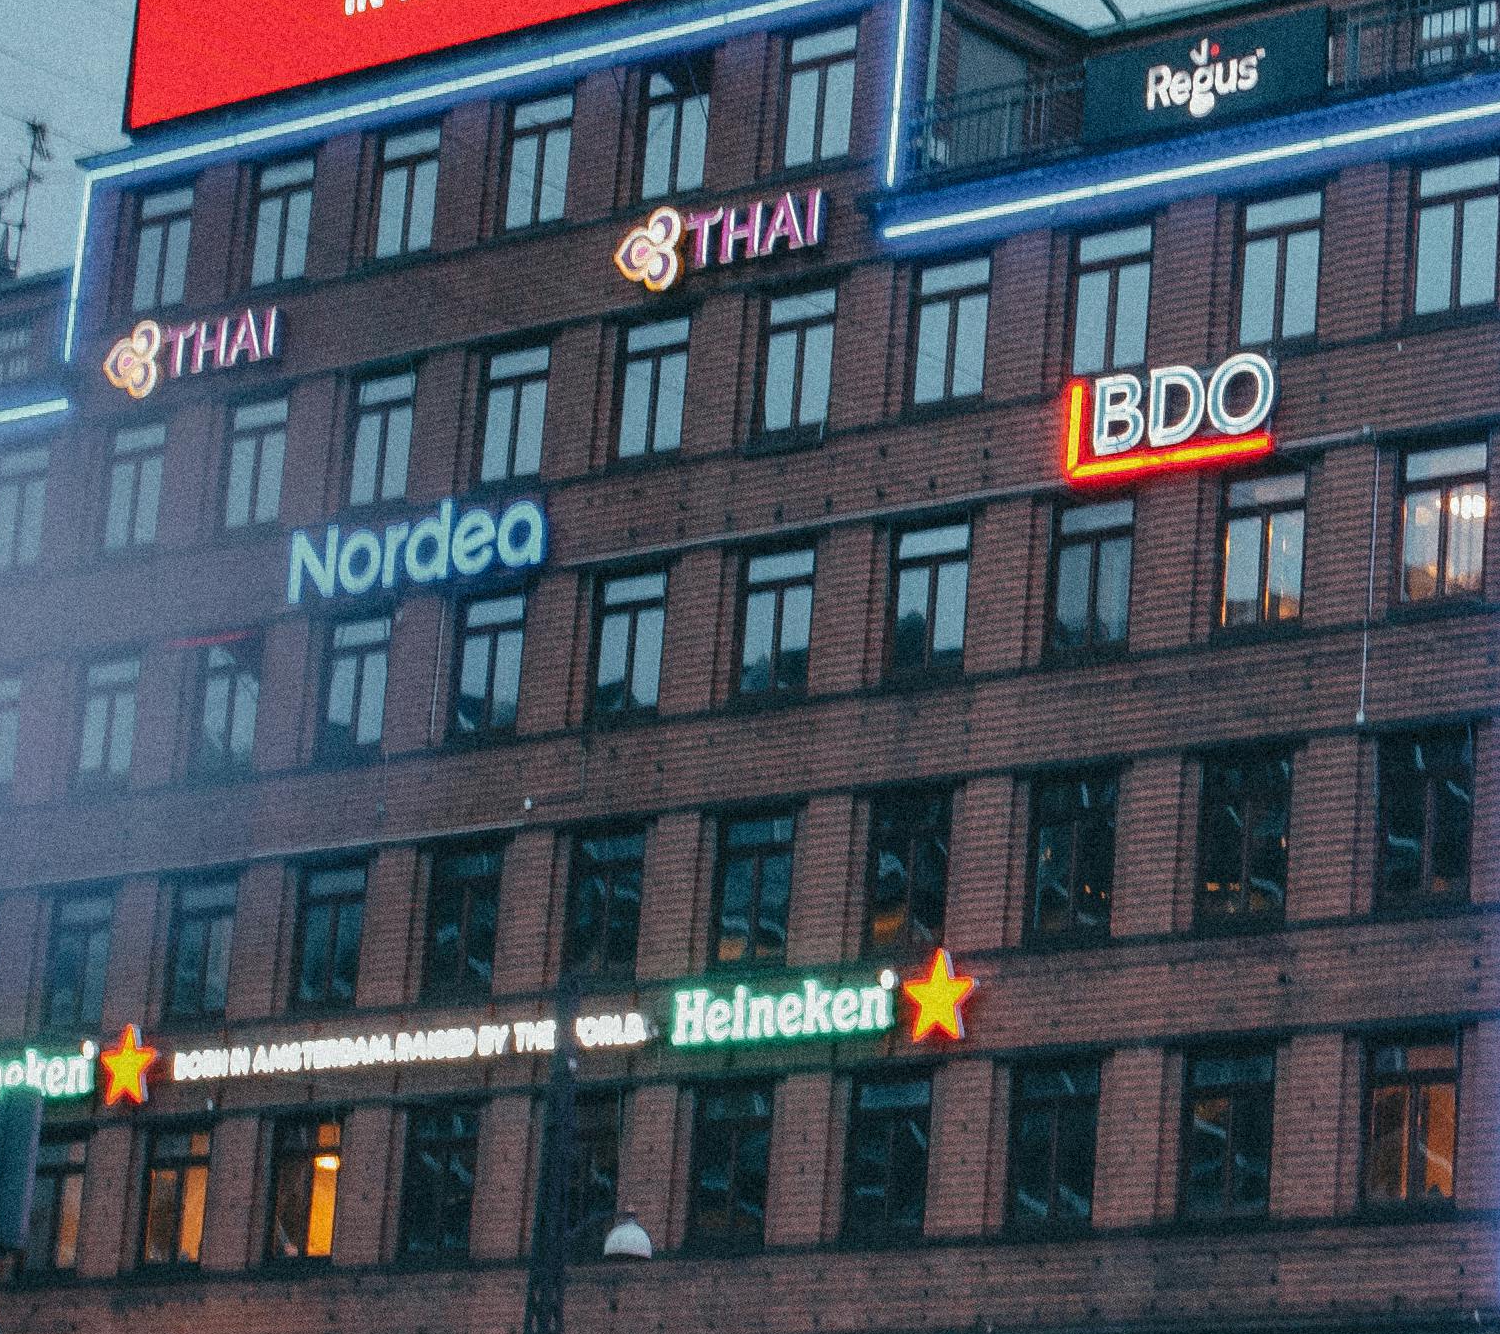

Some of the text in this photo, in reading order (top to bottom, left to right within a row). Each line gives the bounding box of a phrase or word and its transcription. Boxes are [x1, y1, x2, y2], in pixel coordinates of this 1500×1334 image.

[1146, 50, 1260, 117] Regus
[686, 189, 828, 270] THAI
[162, 307, 281, 377] THAI
[1093, 352, 1274, 455] BDO
[289, 499, 546, 604] Nordea
[673, 979, 893, 1045] Heineken
